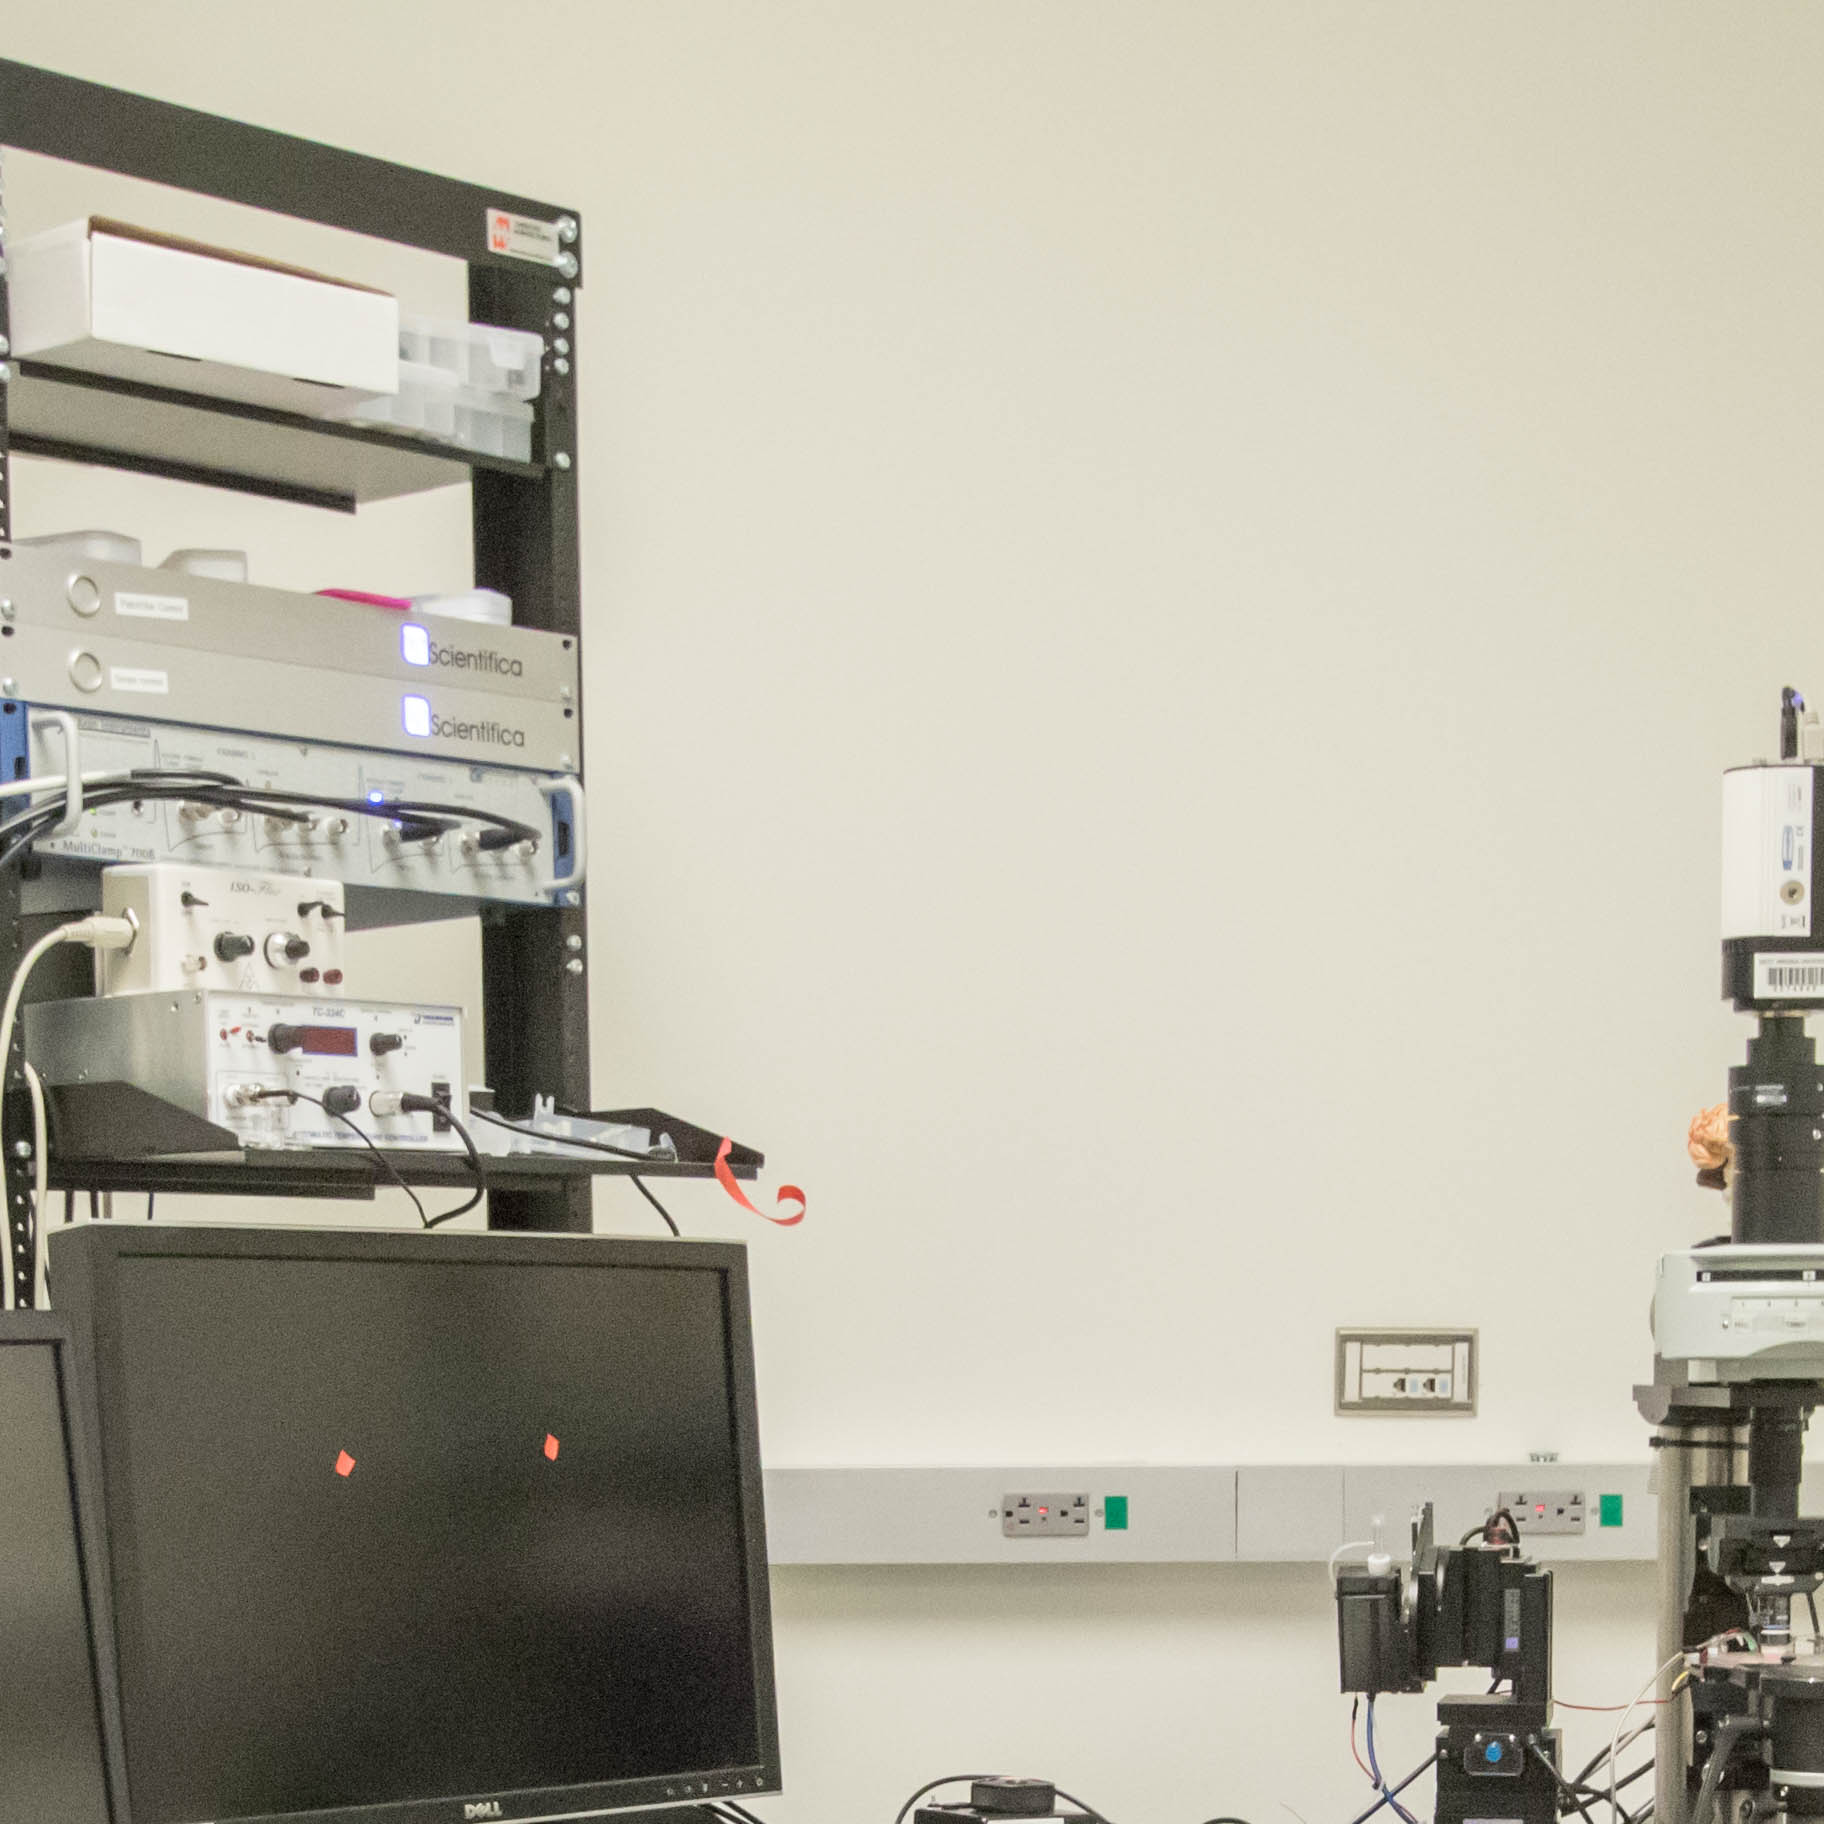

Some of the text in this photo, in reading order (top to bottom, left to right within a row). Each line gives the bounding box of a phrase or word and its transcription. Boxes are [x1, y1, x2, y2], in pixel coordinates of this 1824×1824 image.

[429, 641, 523, 677] Scientifica
[431, 713, 525, 747] Scientifica
[63, 840, 123, 858] MultiClamp
[464, 1801, 503, 1820] DELL
